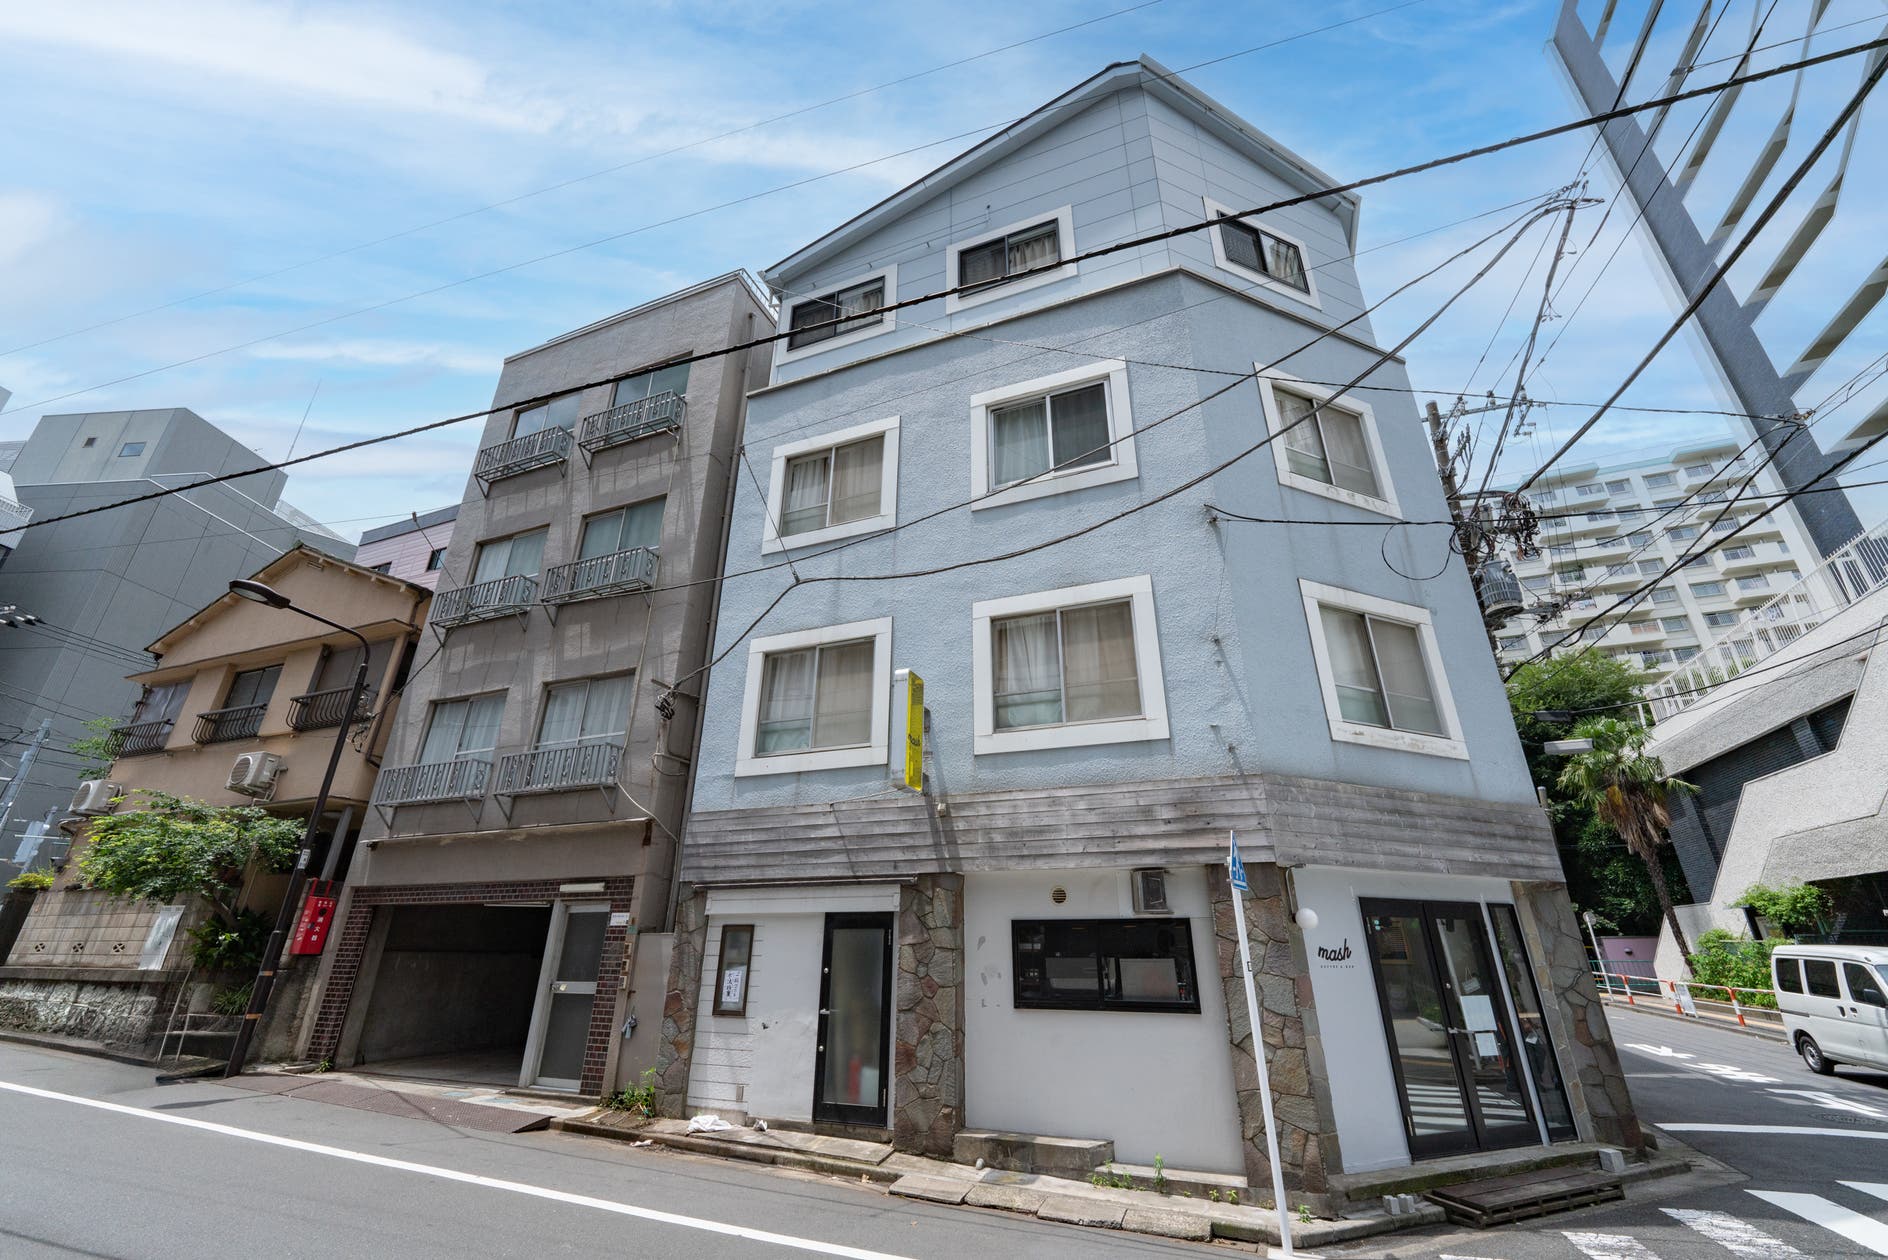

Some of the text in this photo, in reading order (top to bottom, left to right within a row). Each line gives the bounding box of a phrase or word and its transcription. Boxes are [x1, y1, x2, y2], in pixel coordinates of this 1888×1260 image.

[1318, 937, 1352, 961] mash
[1624, 1043, 1888, 1118] 止まれ
